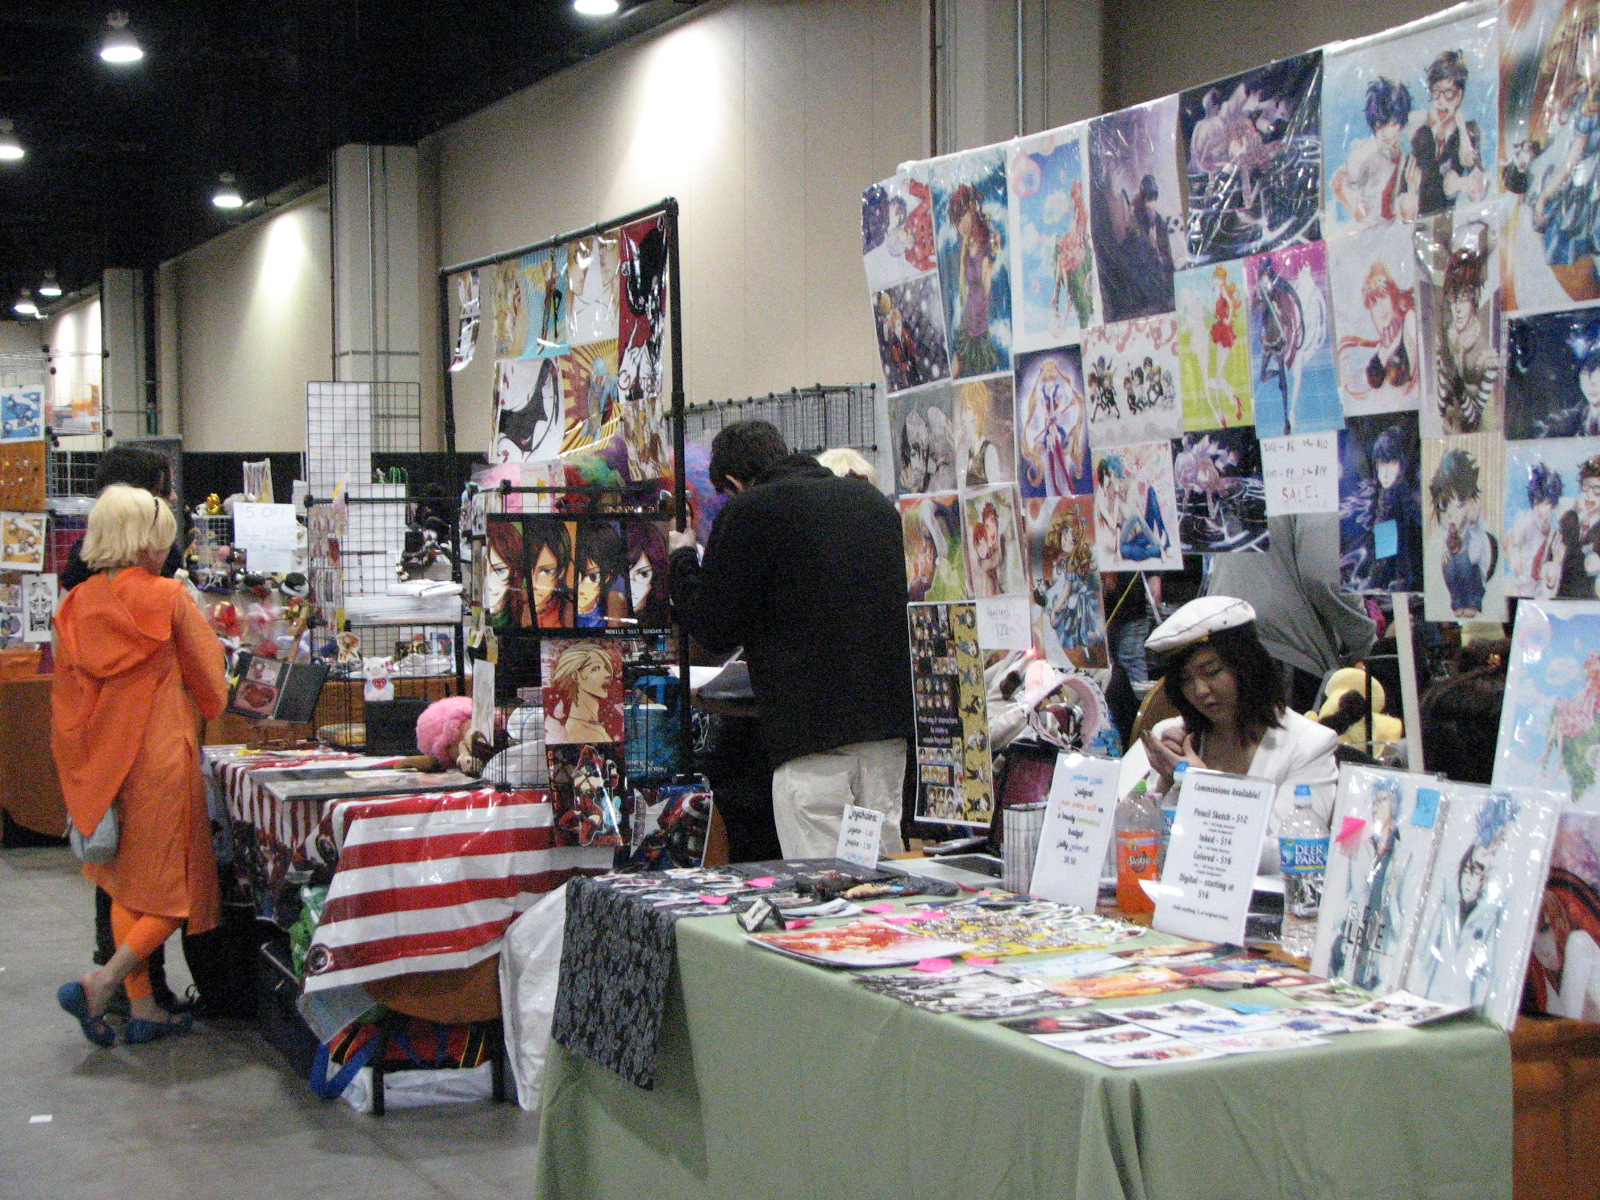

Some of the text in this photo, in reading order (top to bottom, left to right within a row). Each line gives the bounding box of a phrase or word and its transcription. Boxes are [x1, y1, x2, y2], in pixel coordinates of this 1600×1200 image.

[1194, 782, 1230, 796] Commissions
[1193, 807, 1211, 818] Pencil
[1212, 810, 1231, 821] Sketch
[1199, 833, 1215, 844] Inked
[1295, 844, 1323, 855] DEER
[1193, 850, 1215, 862] Colored
[1295, 855, 1323, 865] PARK
[1179, 872, 1198, 884] Digital
[1204, 879, 1227, 891] starting
